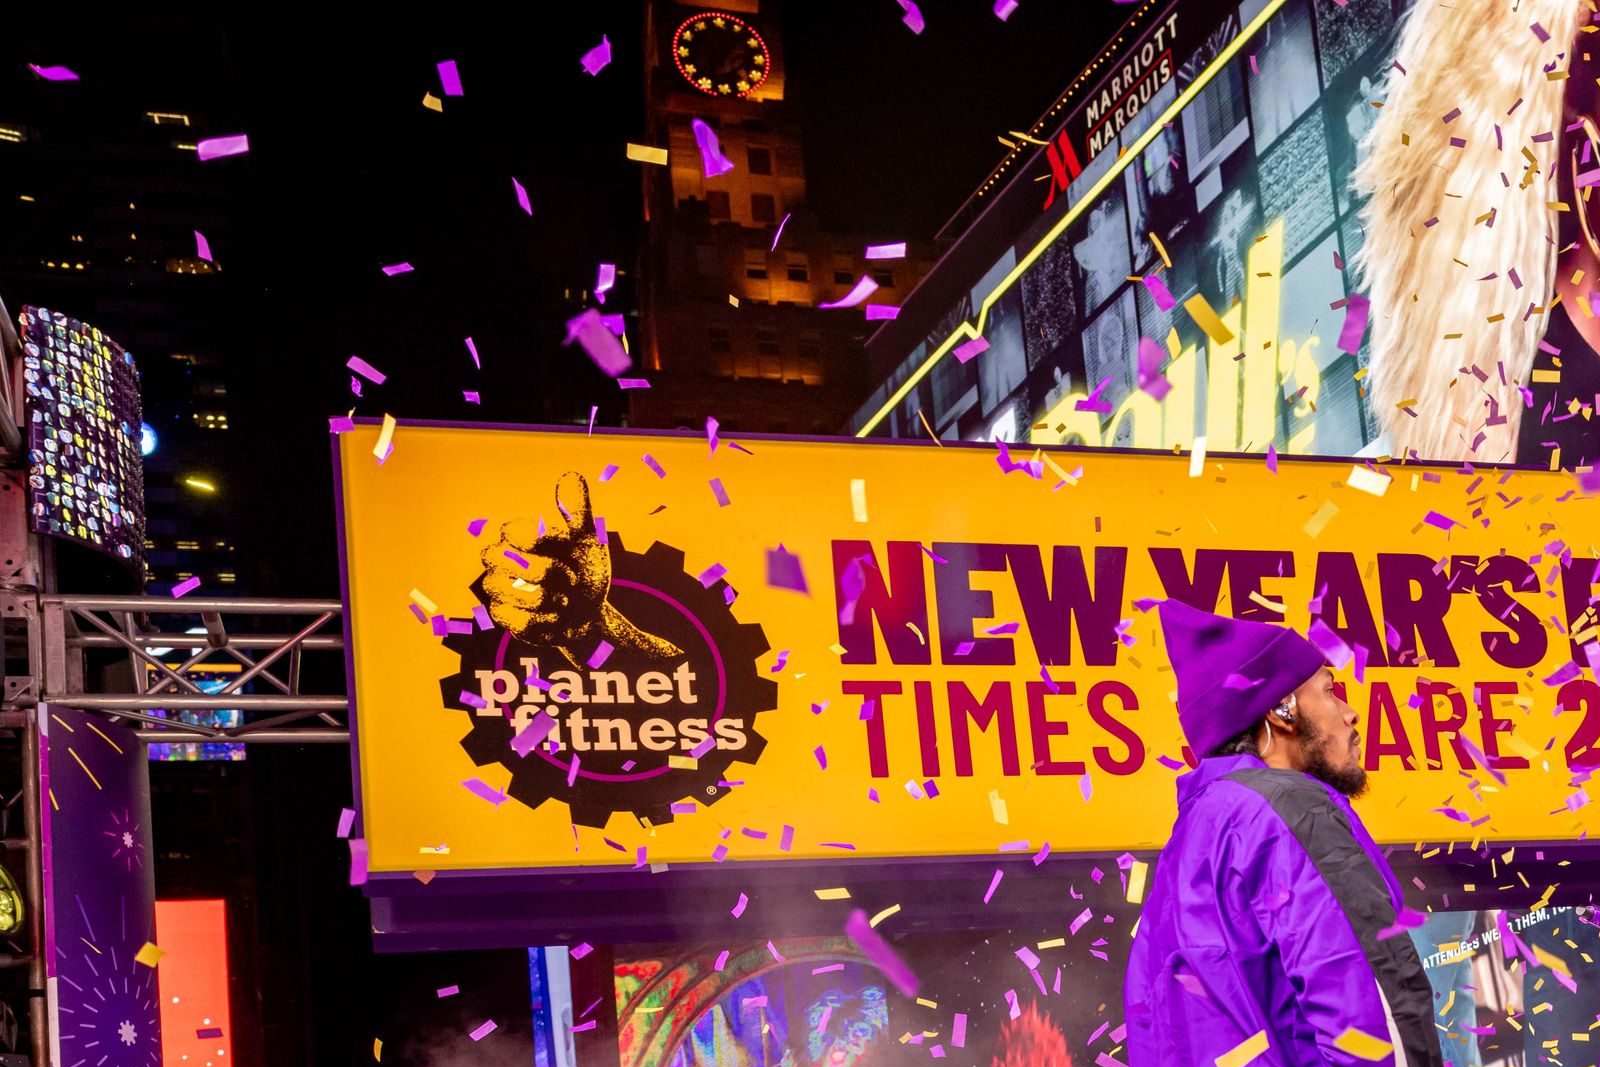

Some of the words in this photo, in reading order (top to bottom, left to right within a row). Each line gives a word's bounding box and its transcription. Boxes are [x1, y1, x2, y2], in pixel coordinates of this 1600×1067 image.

[1086, 12, 1178, 129] MARRIOTT
[1089, 58, 1171, 159] MARQUIS
[830, 539, 1128, 667] NEW
[1147, 547, 1549, 669] YEAR'S
[474, 656, 699, 717] planet
[841, 680, 1146, 778] TIMES
